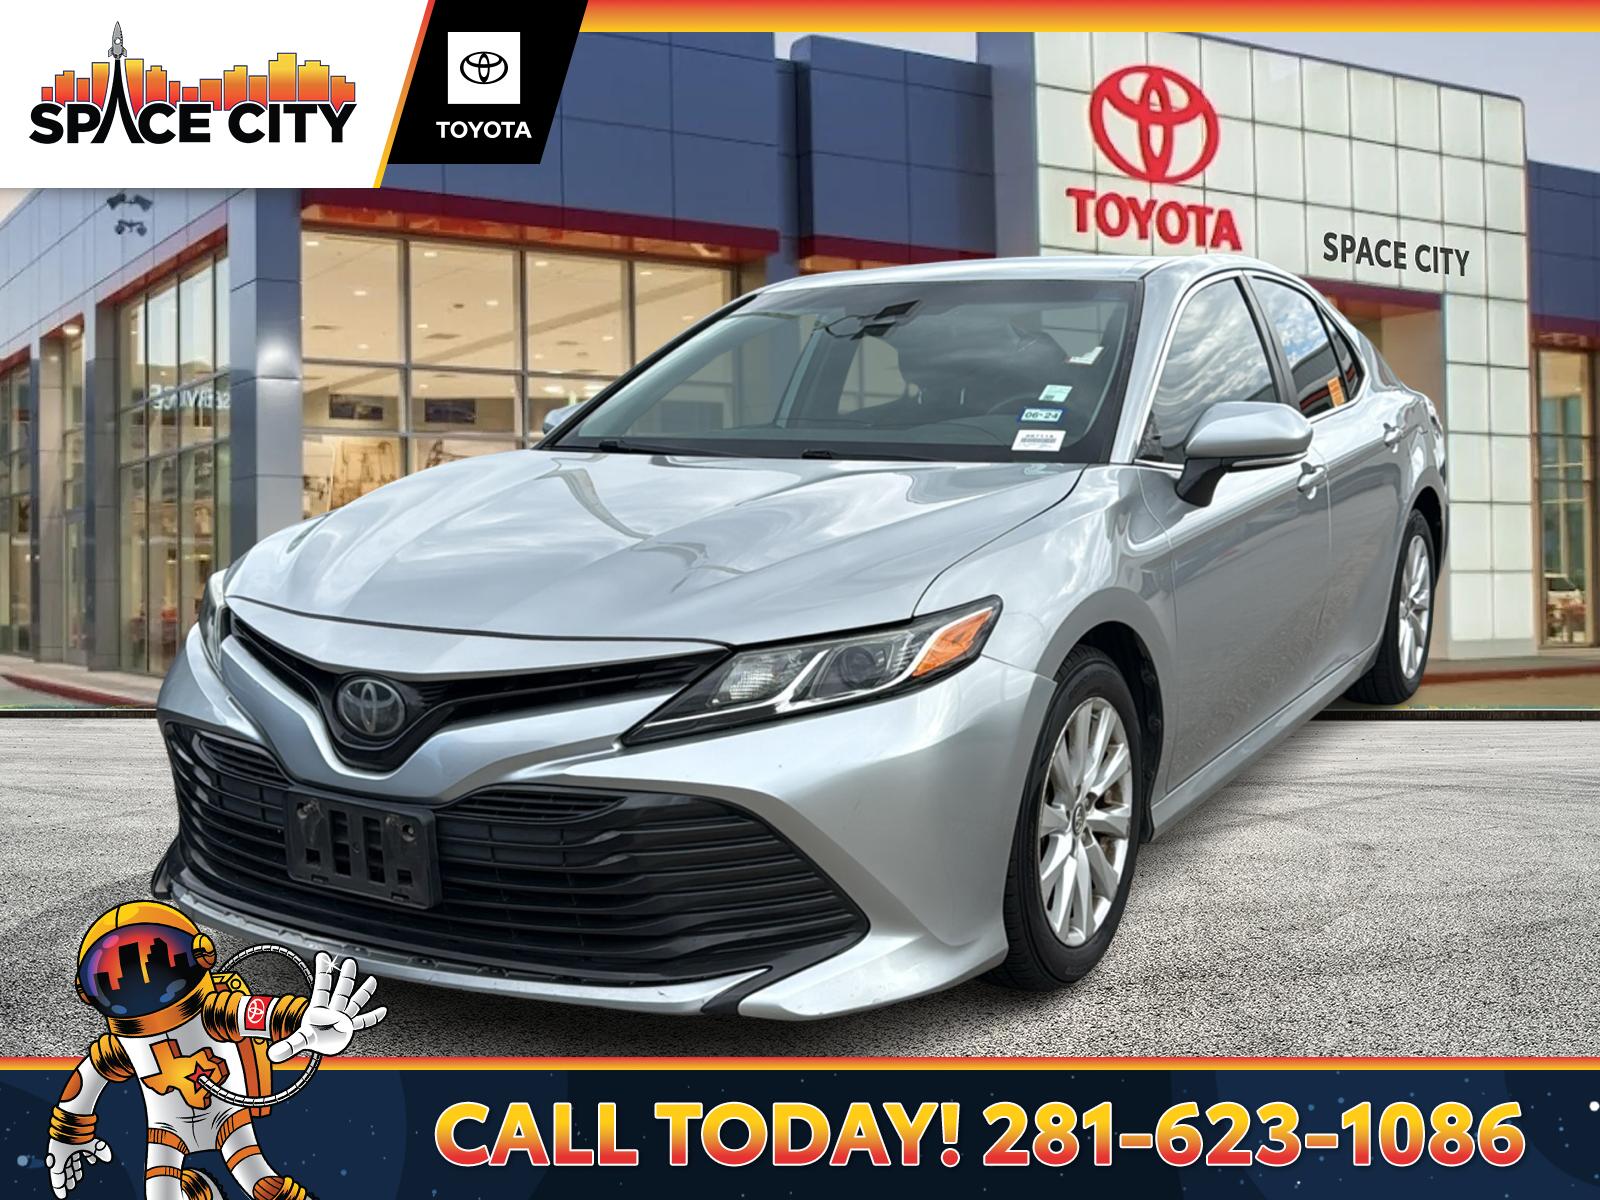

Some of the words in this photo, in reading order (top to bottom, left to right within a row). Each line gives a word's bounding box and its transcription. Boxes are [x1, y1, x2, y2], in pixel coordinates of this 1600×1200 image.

[1066, 187, 1243, 251] TOYOTA
[1322, 231, 1408, 270] SPACE
[1414, 243, 1471, 277] CITY
